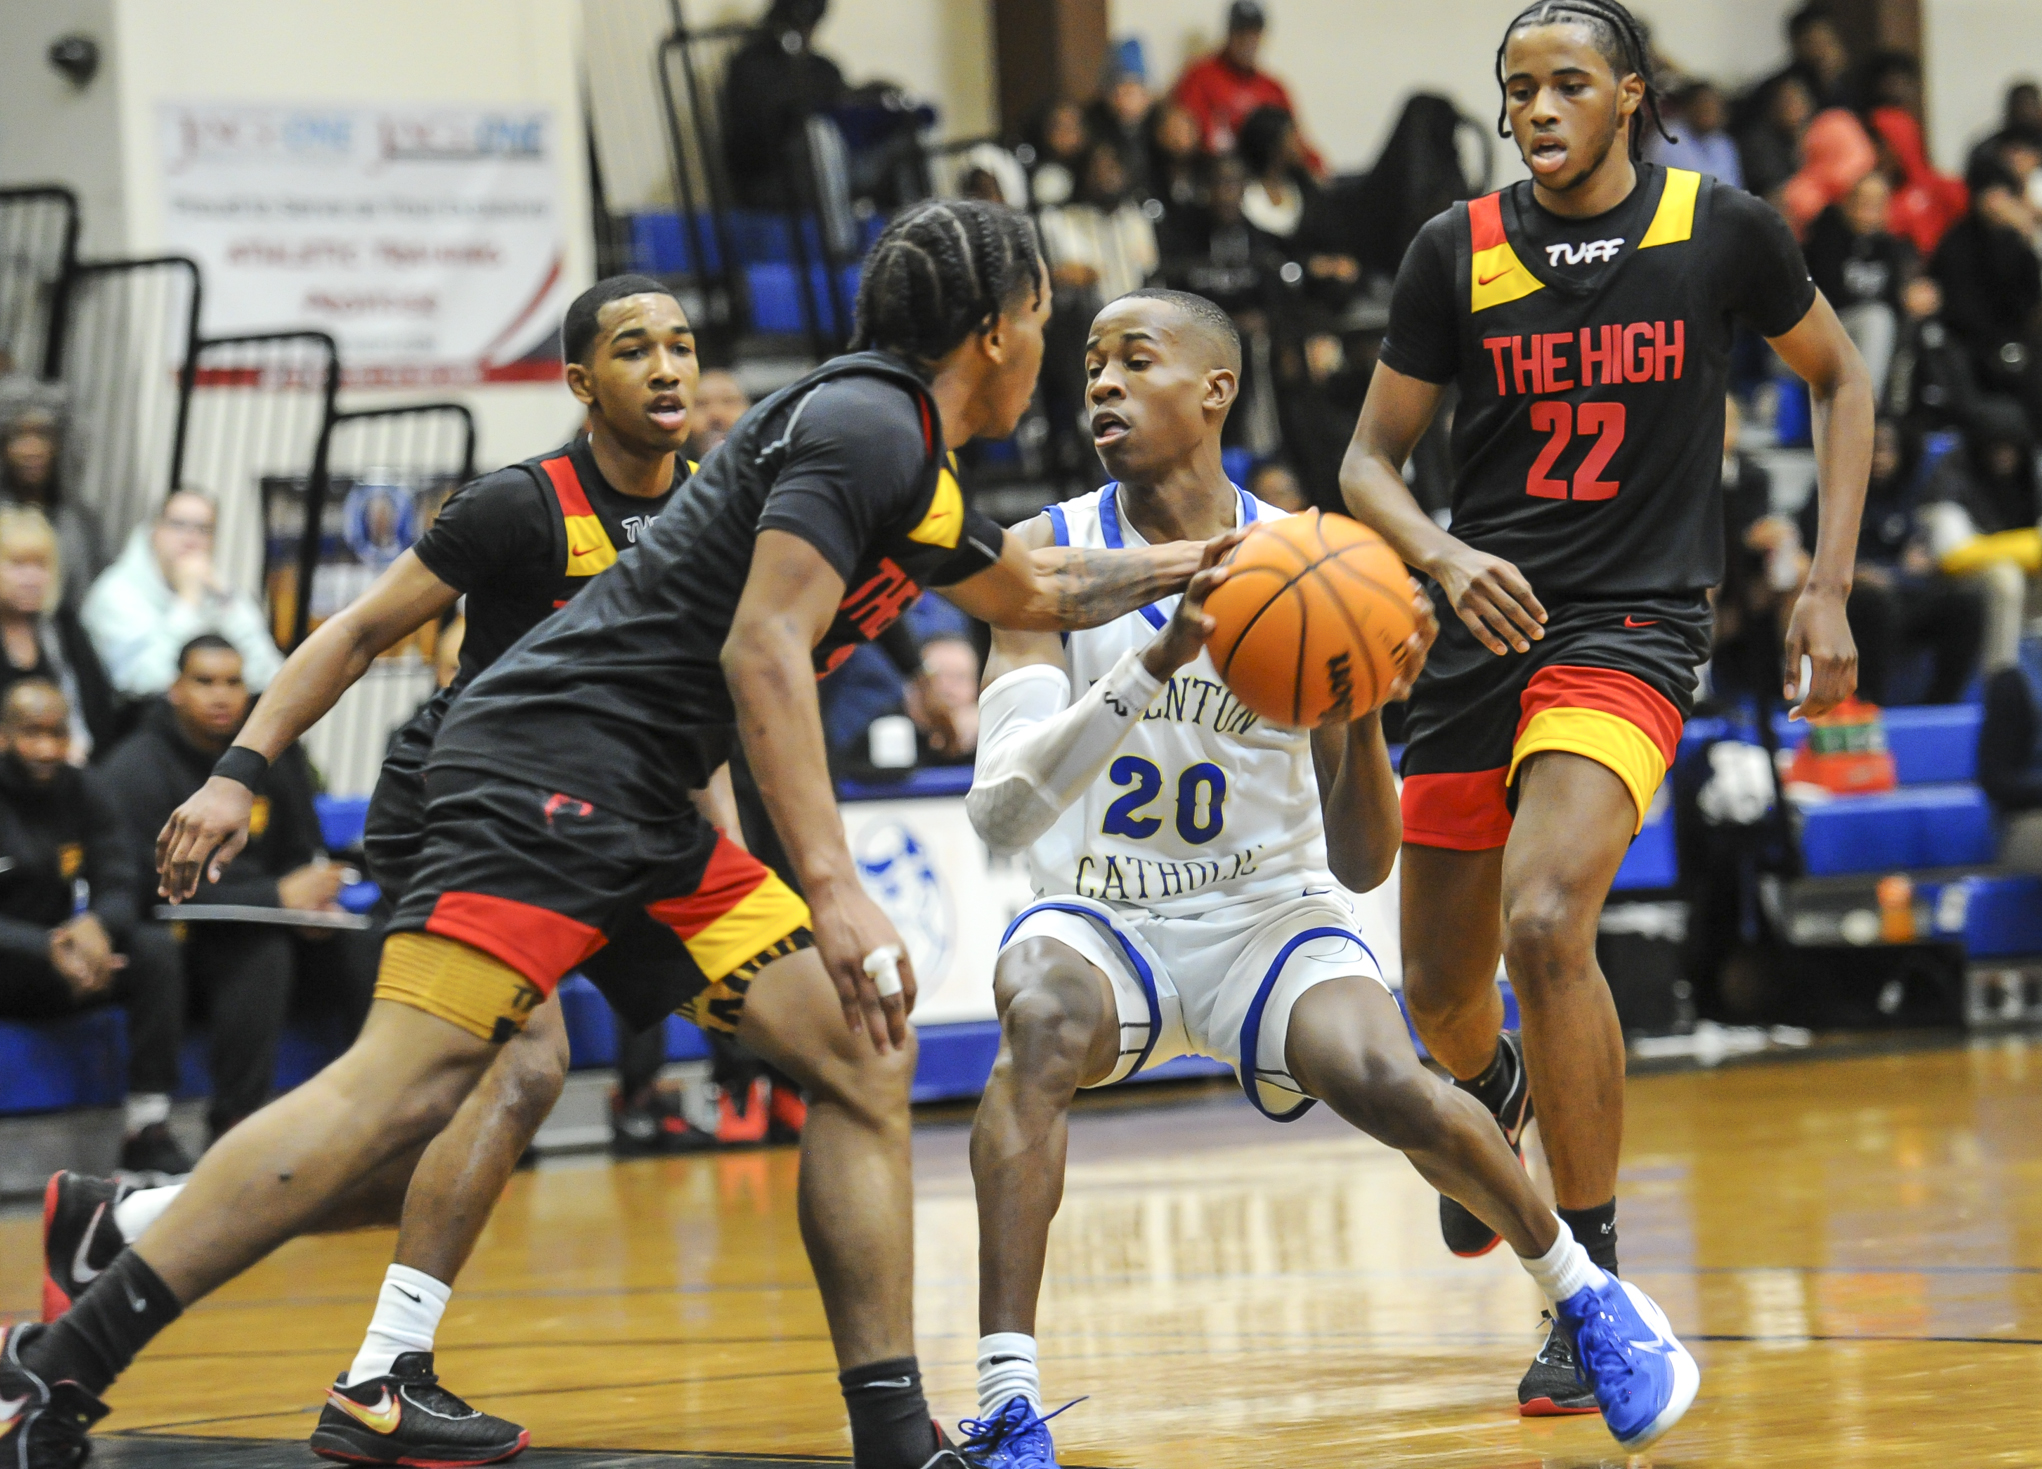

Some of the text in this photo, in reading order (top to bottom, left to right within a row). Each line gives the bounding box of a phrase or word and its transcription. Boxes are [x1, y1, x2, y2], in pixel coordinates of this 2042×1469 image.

[1545, 237, 1625, 267] TUFF
[1482, 320, 1685, 396] THE HIGH
[1525, 401, 1626, 500] 22
[839, 557, 923, 641] THE
[1102, 754, 1228, 845] 20
